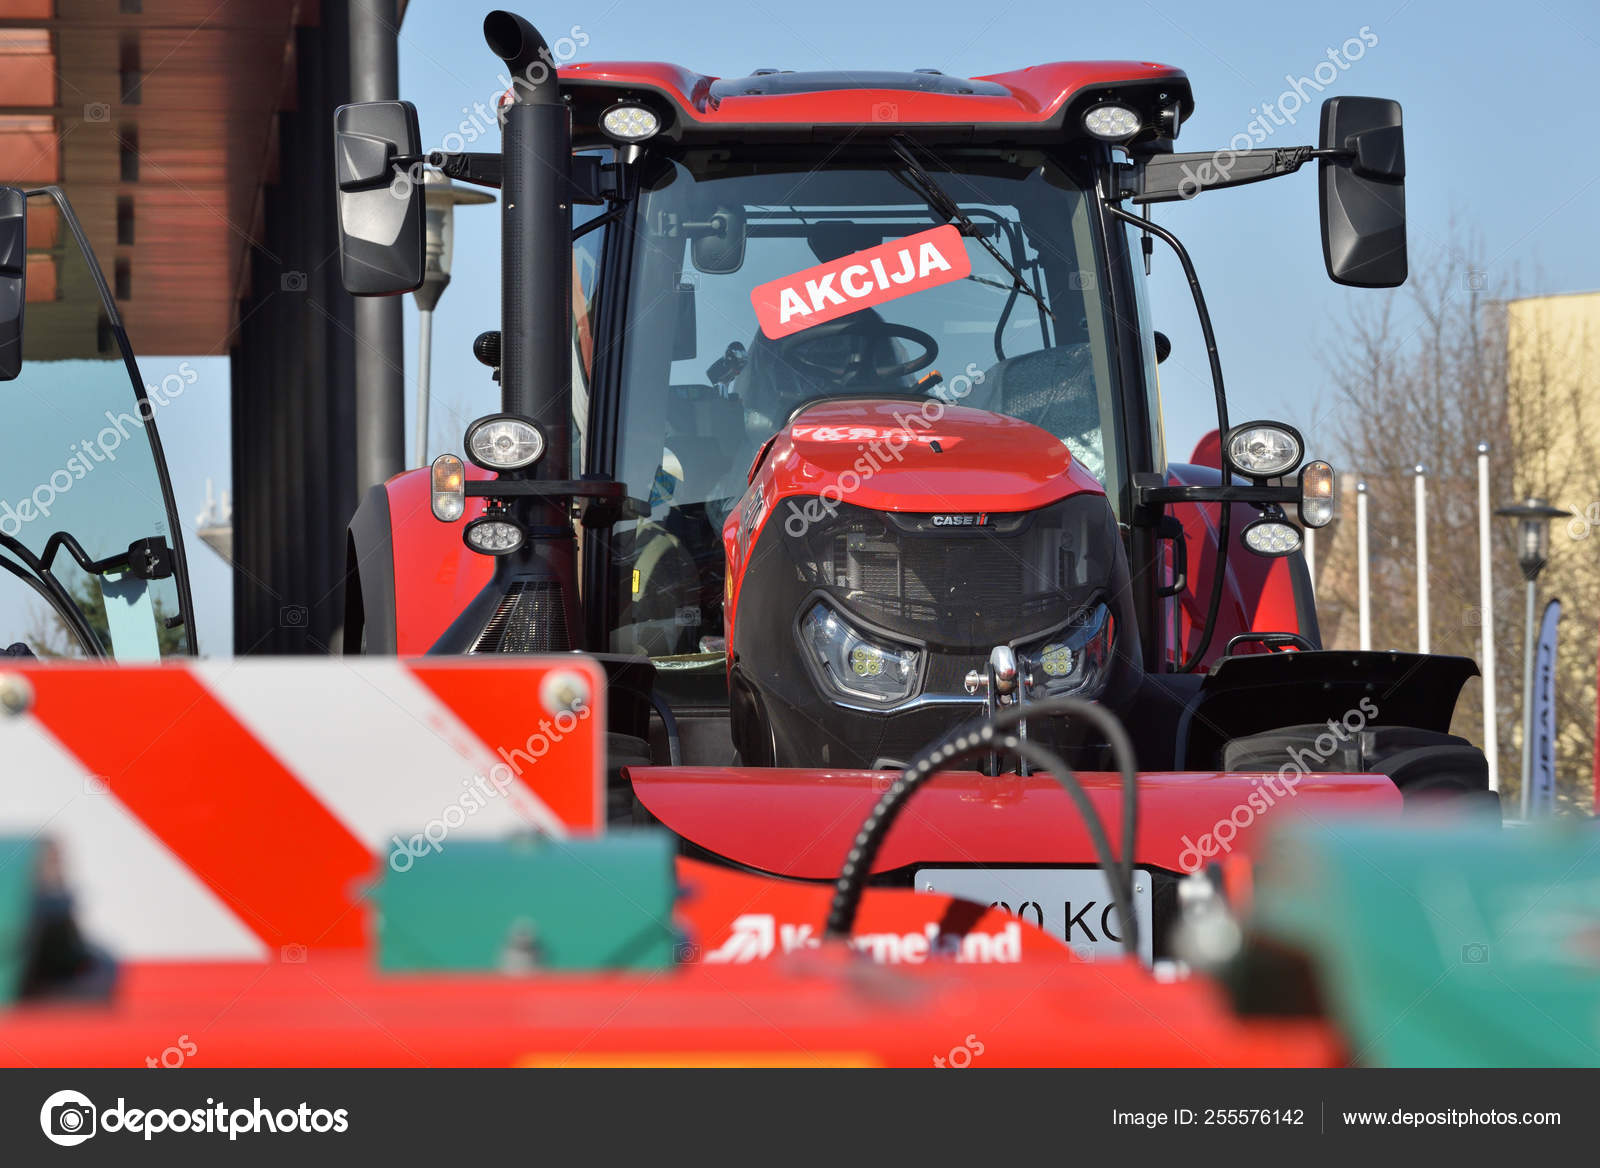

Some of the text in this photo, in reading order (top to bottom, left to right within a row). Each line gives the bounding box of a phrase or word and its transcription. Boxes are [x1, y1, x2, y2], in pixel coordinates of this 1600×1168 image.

[780, 242, 952, 324] AKCIJA
[932, 515, 974, 526] CASE
[1539, 643, 1551, 801] UBARU
